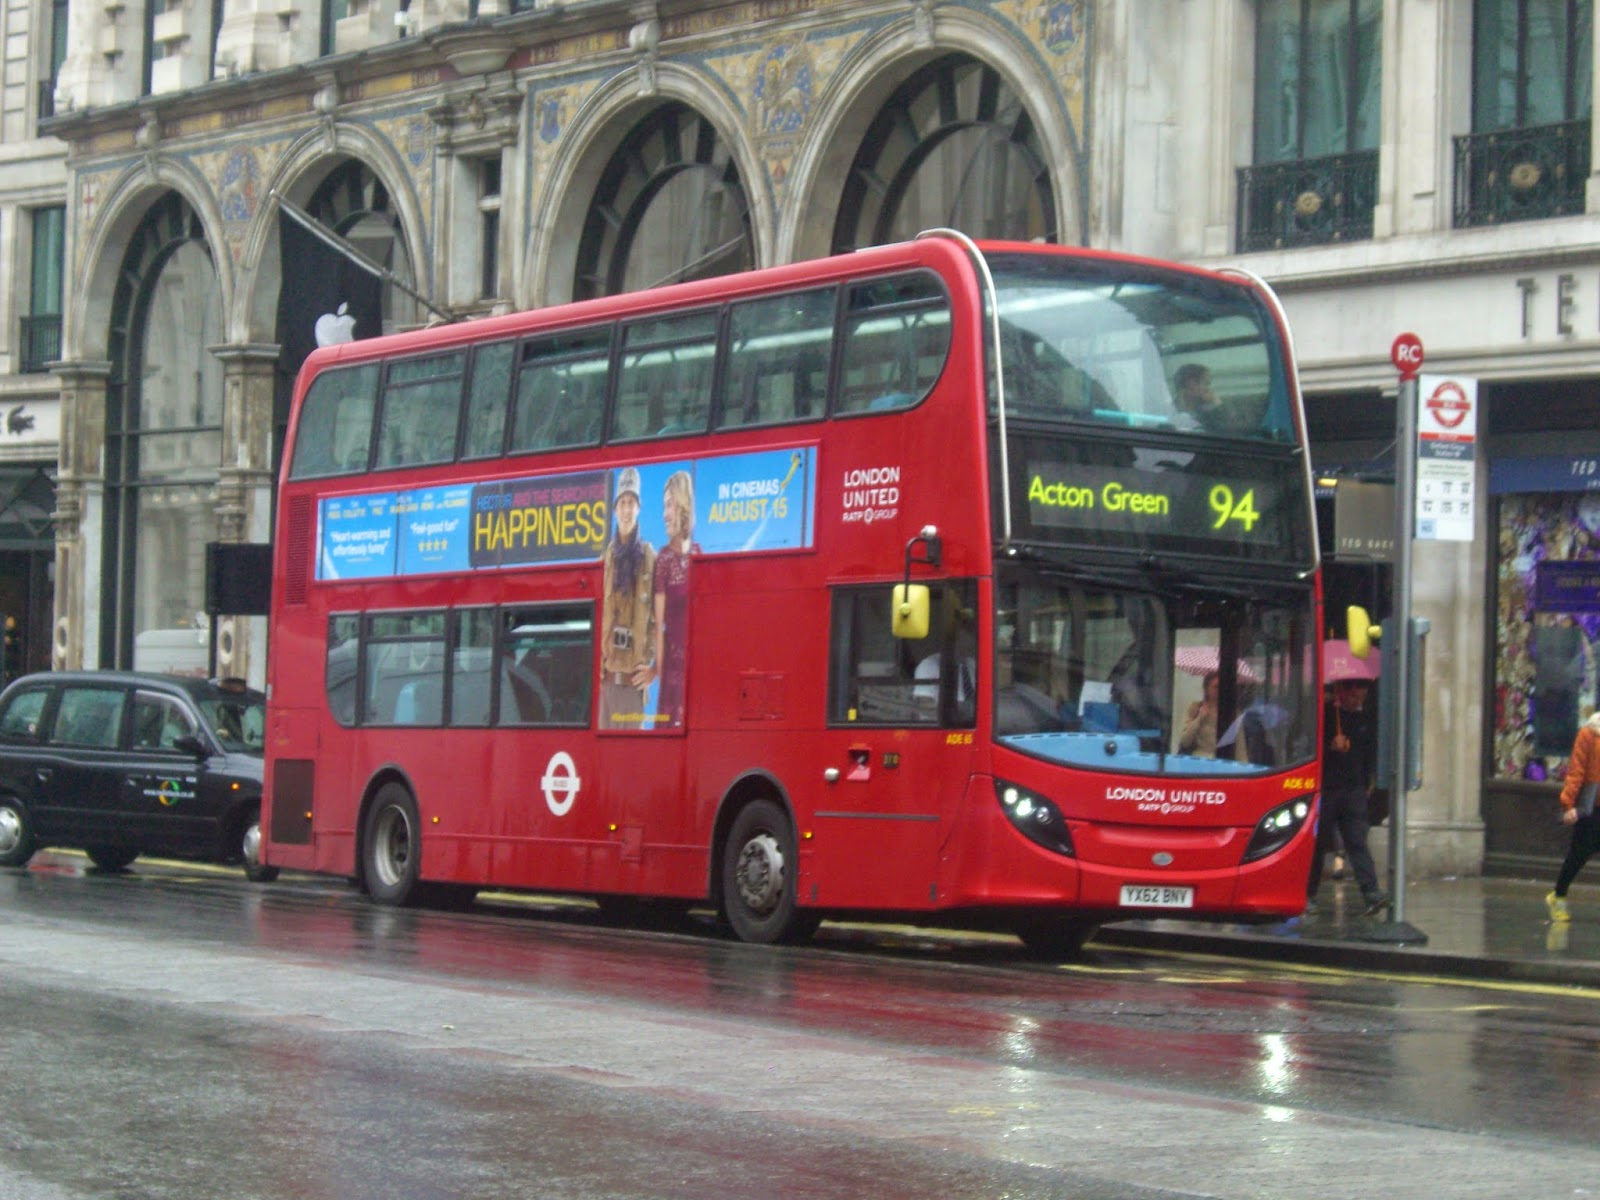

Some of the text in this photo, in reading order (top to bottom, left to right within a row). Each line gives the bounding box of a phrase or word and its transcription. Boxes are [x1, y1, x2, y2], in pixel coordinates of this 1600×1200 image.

[1516, 271, 1600, 338] TE
[1398, 343, 1421, 362] RC
[844, 466, 900, 487] LONDON
[1571, 460, 1597, 476] TED
[719, 478, 780, 499] IN CINEMAS
[843, 487, 899, 508] UNITED
[1028, 475, 1169, 515] Acton Green
[708, 496, 788, 524] AUGUST 15
[1209, 484, 1260, 532] 94
[475, 500, 607, 551] HAPPINESS
[1106, 787, 1226, 804] LONDON UNITED
